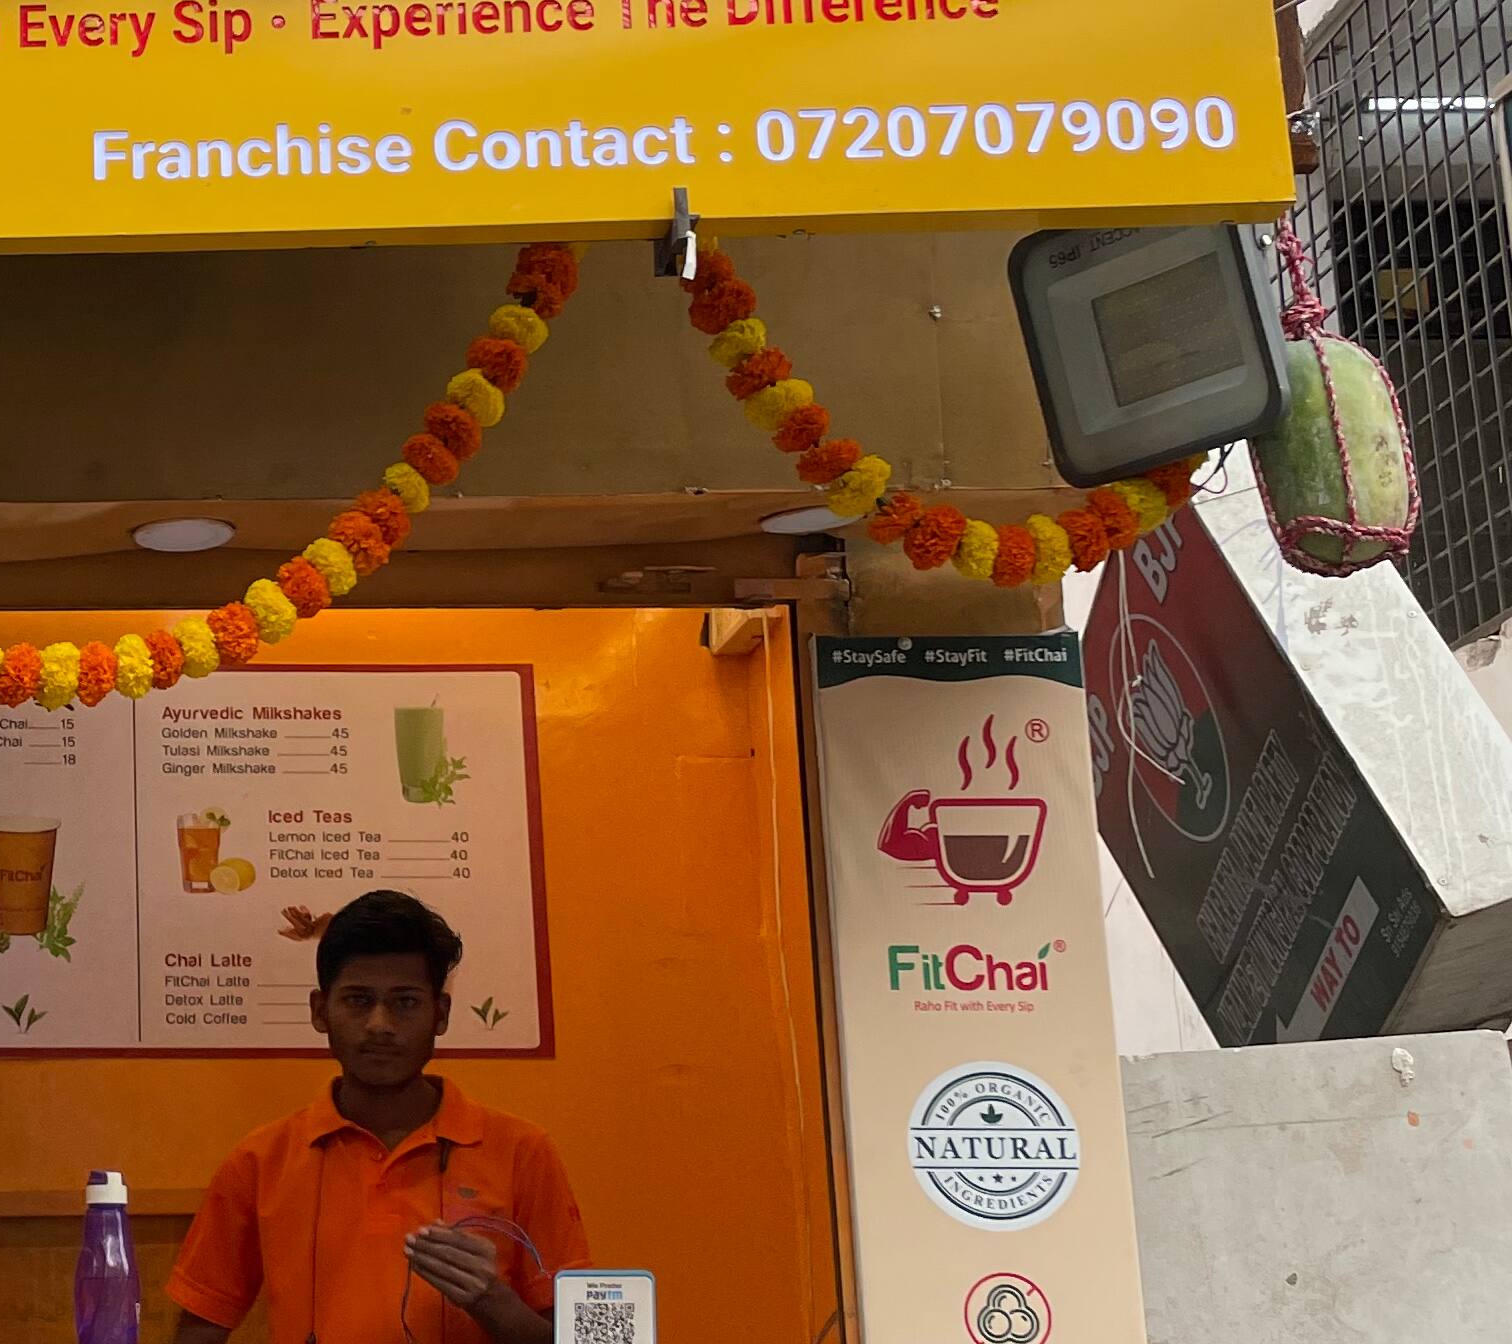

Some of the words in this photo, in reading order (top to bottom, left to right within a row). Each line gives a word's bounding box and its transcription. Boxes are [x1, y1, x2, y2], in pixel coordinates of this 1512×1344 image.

[19, 4, 157, 58] Every
[92, 122, 413, 181] Franchise
[434, 116, 696, 172] Contact
[756, 96, 1235, 161] 07207079090
[1090, 228, 1140, 252] CCENT
[832, 649, 907, 667] #StaySafe
[924, 649, 987, 666] #StayFit
[1004, 648, 1067, 663] #FitChai
[162, 707, 244, 723] Ayurvedic
[252, 707, 342, 720] Milkshakes
[0, 719, 28, 730] Chai
[61, 719, 74, 730] 15
[161, 728, 208, 739] Golden
[214, 728, 277, 739] Milkshake
[331, 728, 349, 739] 45
[62, 736, 76, 748] 15
[162, 745, 200, 756] Tulasi
[206, 745, 270, 756] Milkshake
[330, 745, 348, 756] 45
[63, 754, 76, 765] 18
[162, 763, 205, 777] Ginger
[212, 763, 276, 774] Milkshake
[330, 763, 348, 774] 45
[268, 810, 304, 823] Iced
[313, 810, 353, 823] Teas
[269, 831, 316, 843] Lemon
[322, 831, 351, 843] Iced
[358, 831, 382, 843] Tea
[451, 831, 469, 843] 40
[269, 849, 314, 860] FitChai
[320, 849, 349, 860] Iced
[356, 849, 380, 860] Tea
[450, 849, 468, 860] 40
[270, 867, 308, 878] Detox
[314, 867, 343, 878] Iced
[350, 867, 374, 878] Tea
[453, 867, 471, 879] 40
[165, 953, 202, 968] Chai
[210, 953, 252, 968] Latte
[888, 941, 1050, 991] FitChai
[1310, 949, 1342, 1012] WAY
[1335, 914, 1360, 954] TO
[165, 975, 210, 987] FitChai
[217, 975, 250, 987] Latte
[165, 994, 203, 1006] Detox
[210, 994, 243, 1006] Latte
[166, 1013, 196, 1025] Cold
[203, 1013, 247, 1025] Coffee
[935, 1091, 969, 1120] 100%
[975, 1082, 1051, 1122] ORGANIC
[914, 1137, 1077, 1160] NATURAL
[944, 1175, 1054, 1210] INGREDIENTS
